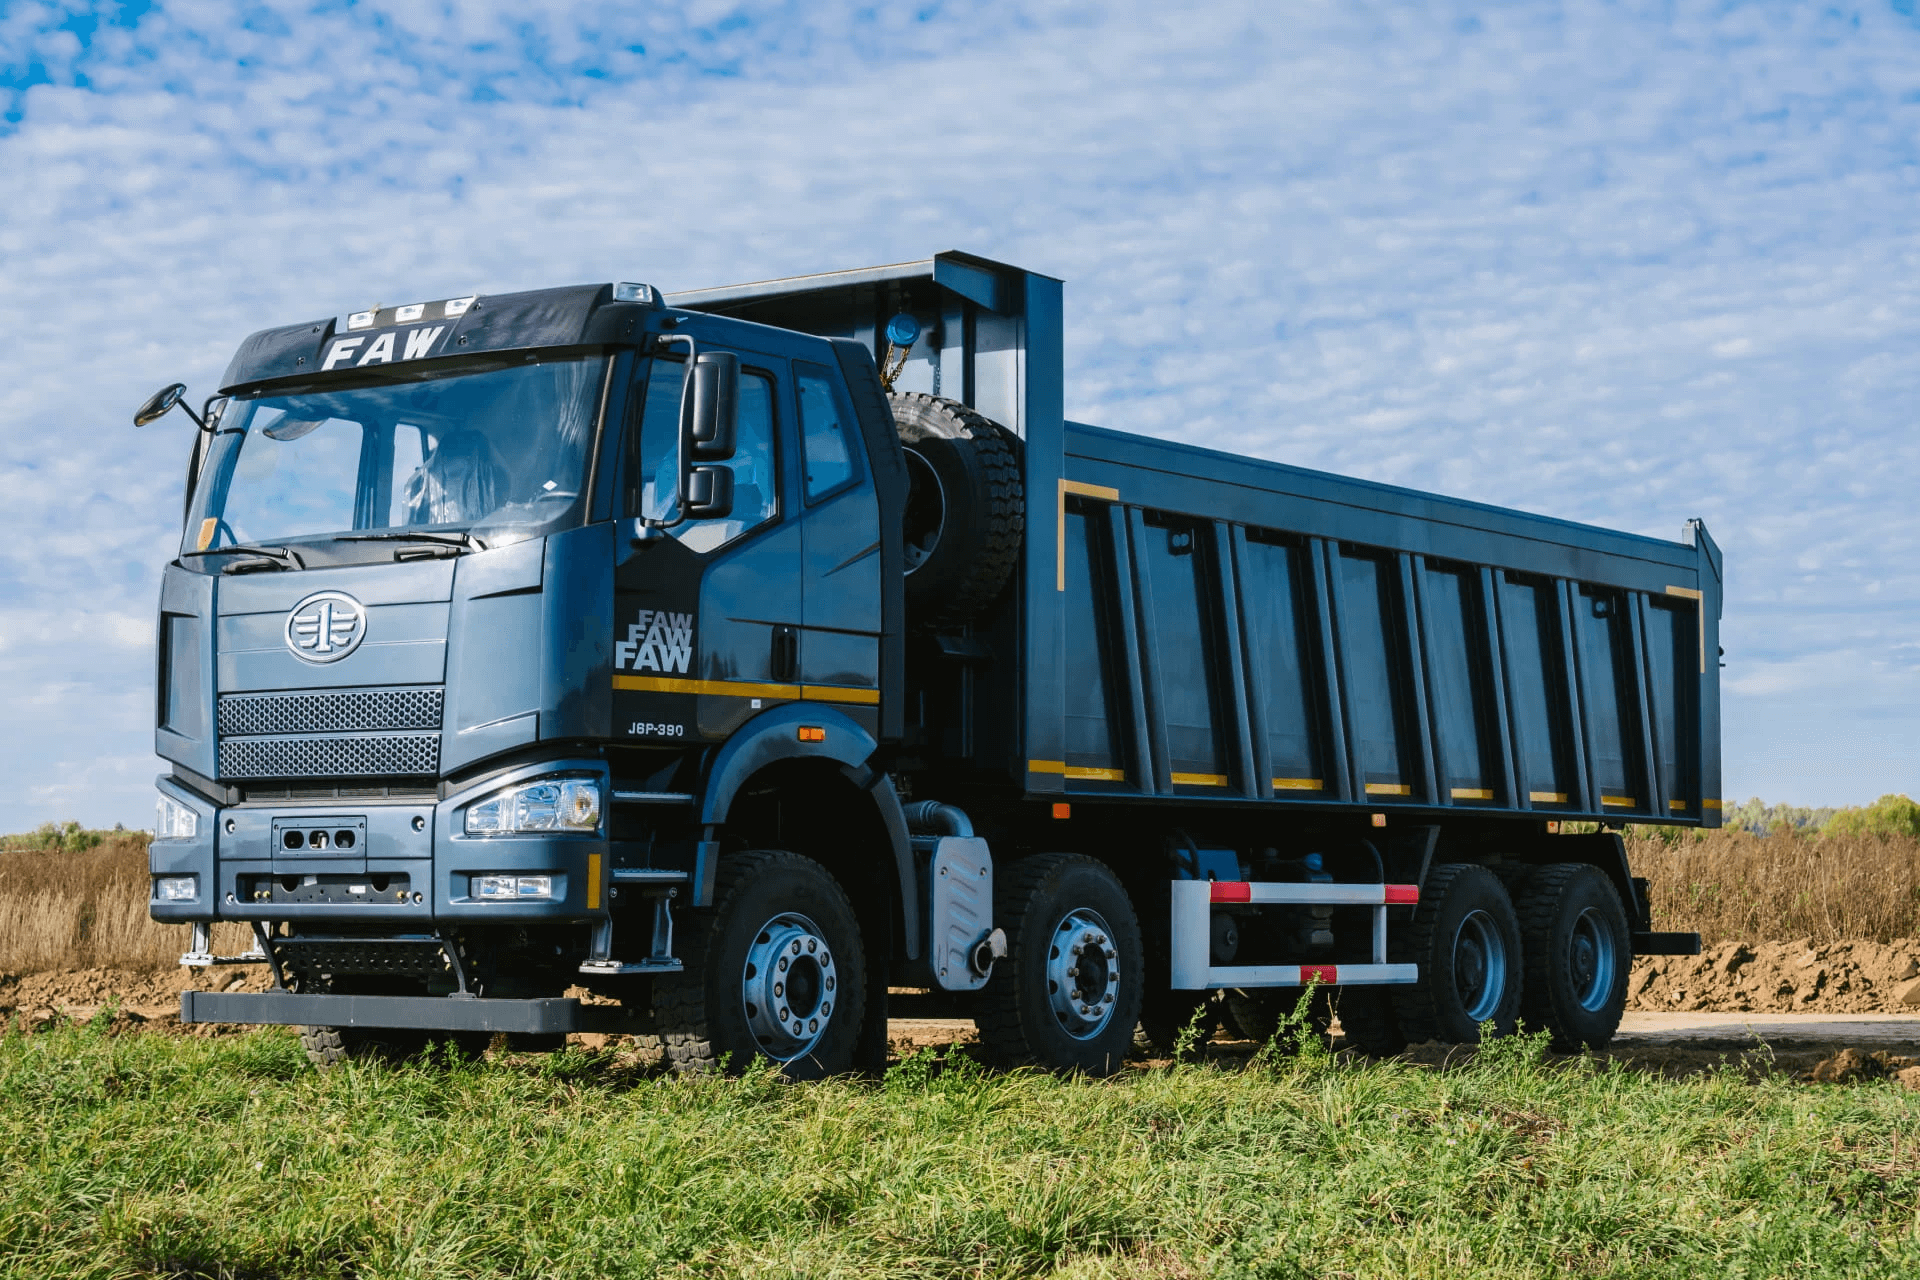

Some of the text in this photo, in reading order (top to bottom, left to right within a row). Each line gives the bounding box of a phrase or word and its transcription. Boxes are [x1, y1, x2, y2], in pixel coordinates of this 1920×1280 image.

[321, 326, 445, 371] FAW
[638, 609, 692, 632] FAW
[628, 624, 692, 652] FAW
[615, 641, 692, 673] FAW
[628, 722, 683, 736] J6P-390
